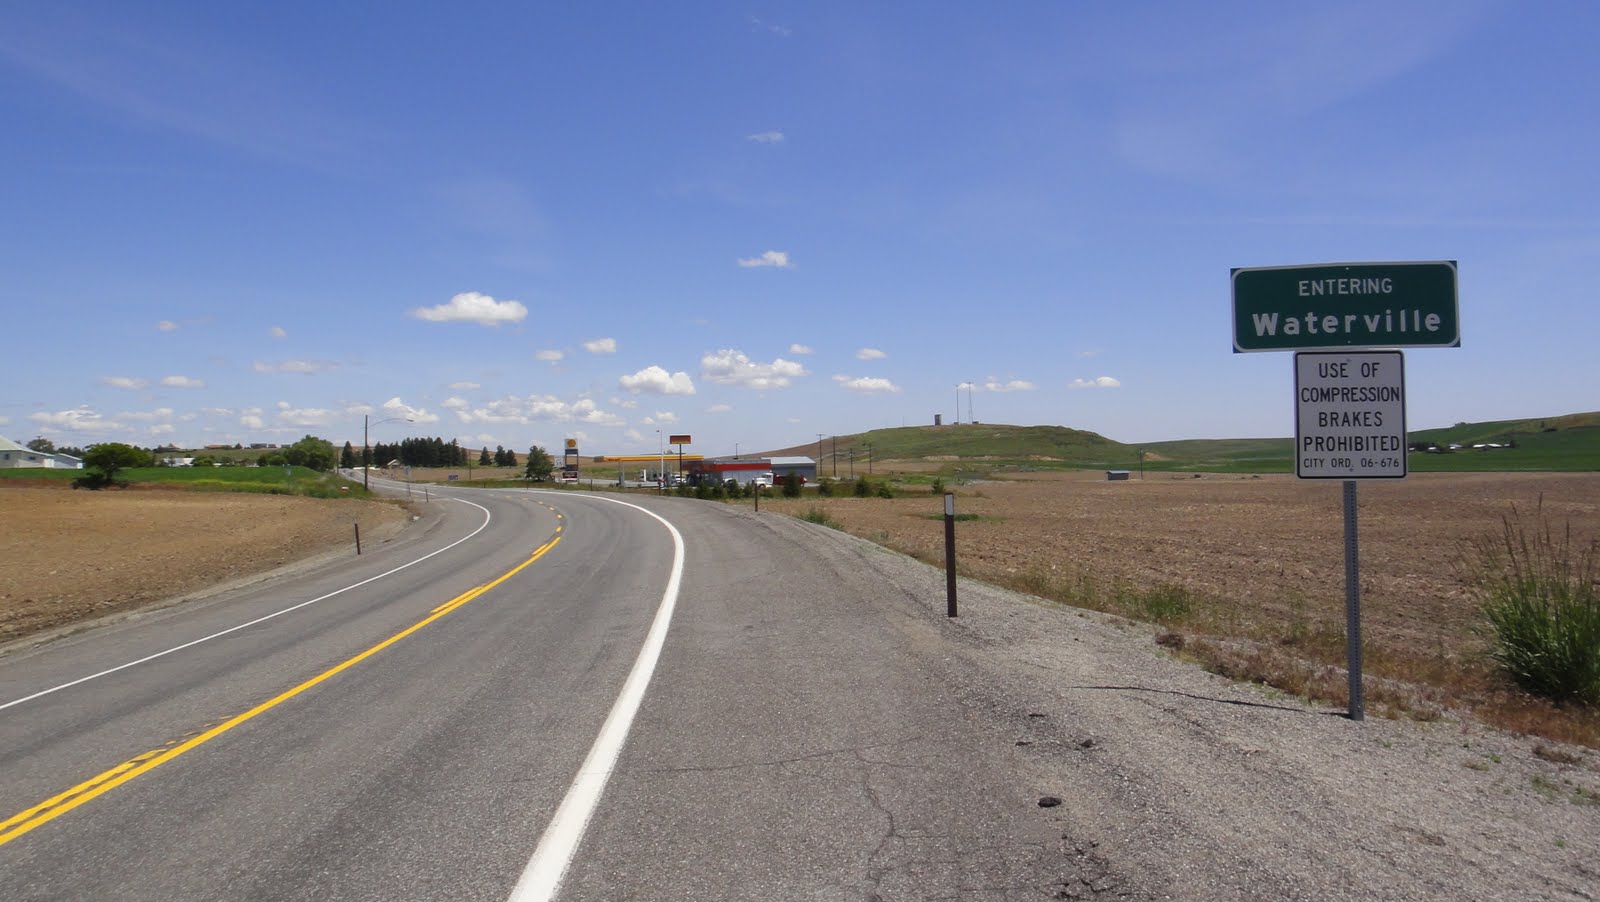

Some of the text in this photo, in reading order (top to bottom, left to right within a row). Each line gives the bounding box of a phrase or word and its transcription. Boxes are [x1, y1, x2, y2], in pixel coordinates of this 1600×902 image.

[1299, 278, 1392, 296] ENTERING
[1252, 309, 1441, 336] Waterville
[1318, 362, 1381, 378] USE OF
[1301, 386, 1400, 402] COMPRESSION
[1318, 411, 1383, 427] BRAKES
[1303, 435, 1400, 452] PROHIBITED
[1303, 458, 1325, 468] CITY
[1361, 458, 1399, 468] 06-676
